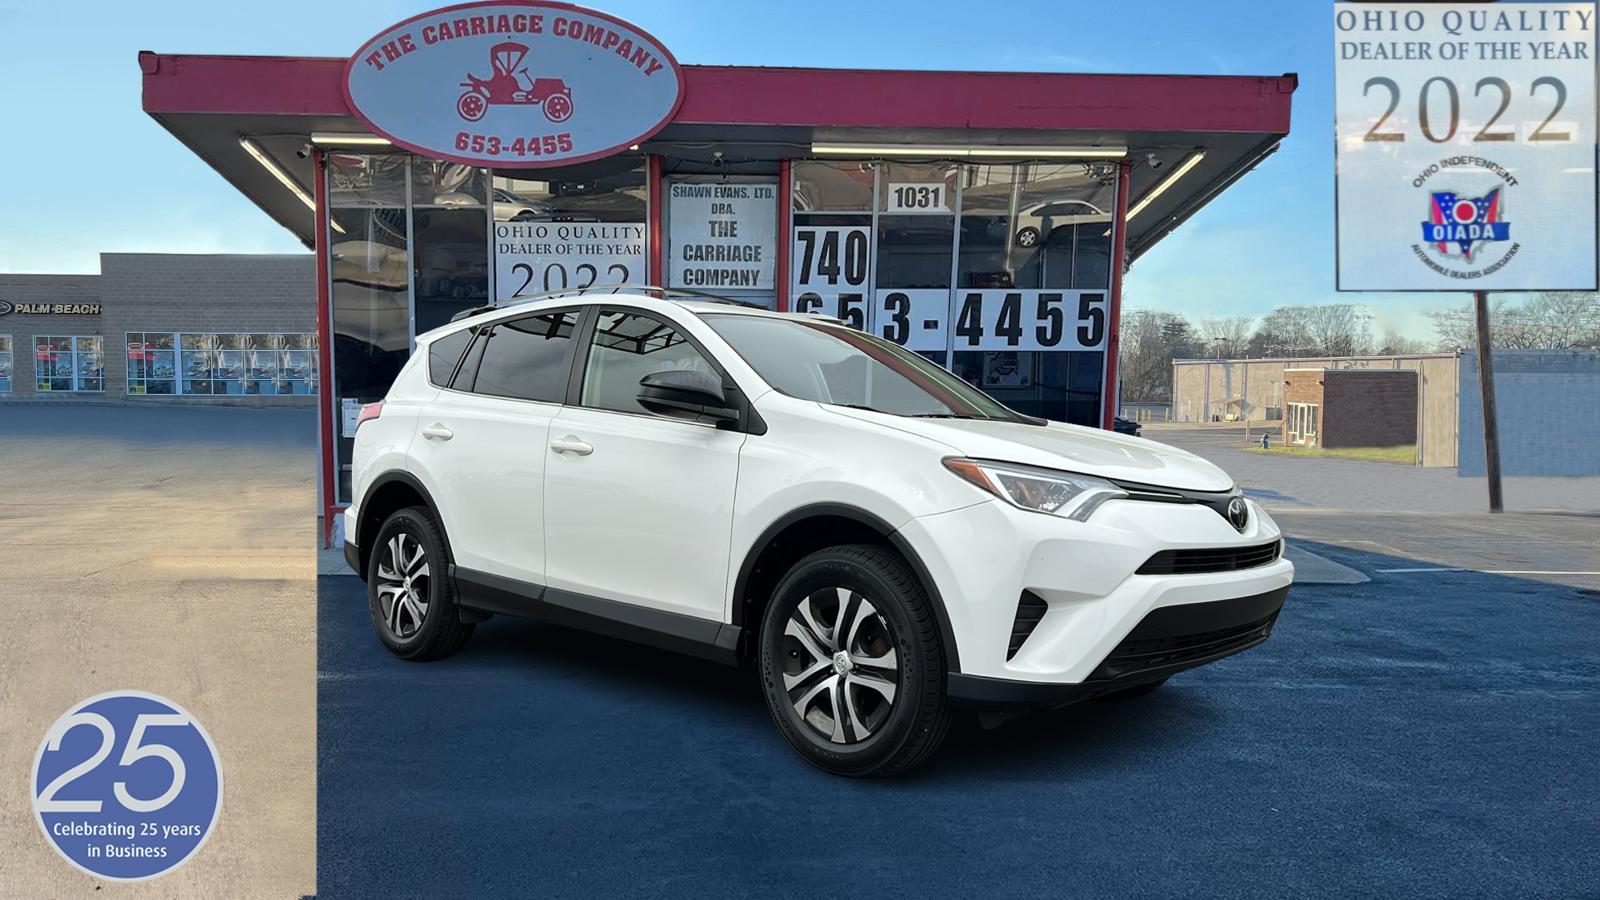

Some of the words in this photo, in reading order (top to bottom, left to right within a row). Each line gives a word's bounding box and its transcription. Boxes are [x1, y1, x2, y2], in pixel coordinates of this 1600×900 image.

[1336, 10, 1425, 31] OHIO
[1442, 10, 1592, 36] QUALITY
[366, 33, 417, 71] THE
[422, 14, 544, 46] CARRIAGE
[552, 16, 664, 77] COMPANY
[1340, 42, 1433, 60] DEALER
[1438, 42, 1469, 60] OF
[1475, 42, 1522, 60] THE
[1528, 42, 1589, 60] YEAR
[1362, 76, 1571, 144] 2022
[454, 131, 573, 156] 653-4455
[1412, 163, 1440, 188] OHIO
[1440, 155, 1519, 187] INDEPENDENT
[672, 185, 712, 198] SHAWN
[754, 187, 775, 199] LTD.
[894, 186, 941, 208] 1031
[711, 203, 736, 215] DBA.
[497, 225, 548, 239] OHIO
[557, 226, 644, 241] QUALITY
[708, 220, 738, 238] THE
[1432, 224, 1495, 241] OIADA
[499, 243, 552, 255] DEALER
[555, 244, 574, 255] OF
[576, 244, 603, 255] THE
[607, 244, 641, 255] YEAR
[683, 244, 762, 262] CARRIAGE
[797, 230, 867, 286] 740
[1411, 243, 1449, 277] AUTOMOBILE
[1450, 269, 1482, 279] DEALERS
[1482, 242, 1520, 276] ASSOCIATION
[683, 268, 761, 286] COMPANY
[15, 303, 51, 314] PALM
[54, 303, 101, 314] BEACH
